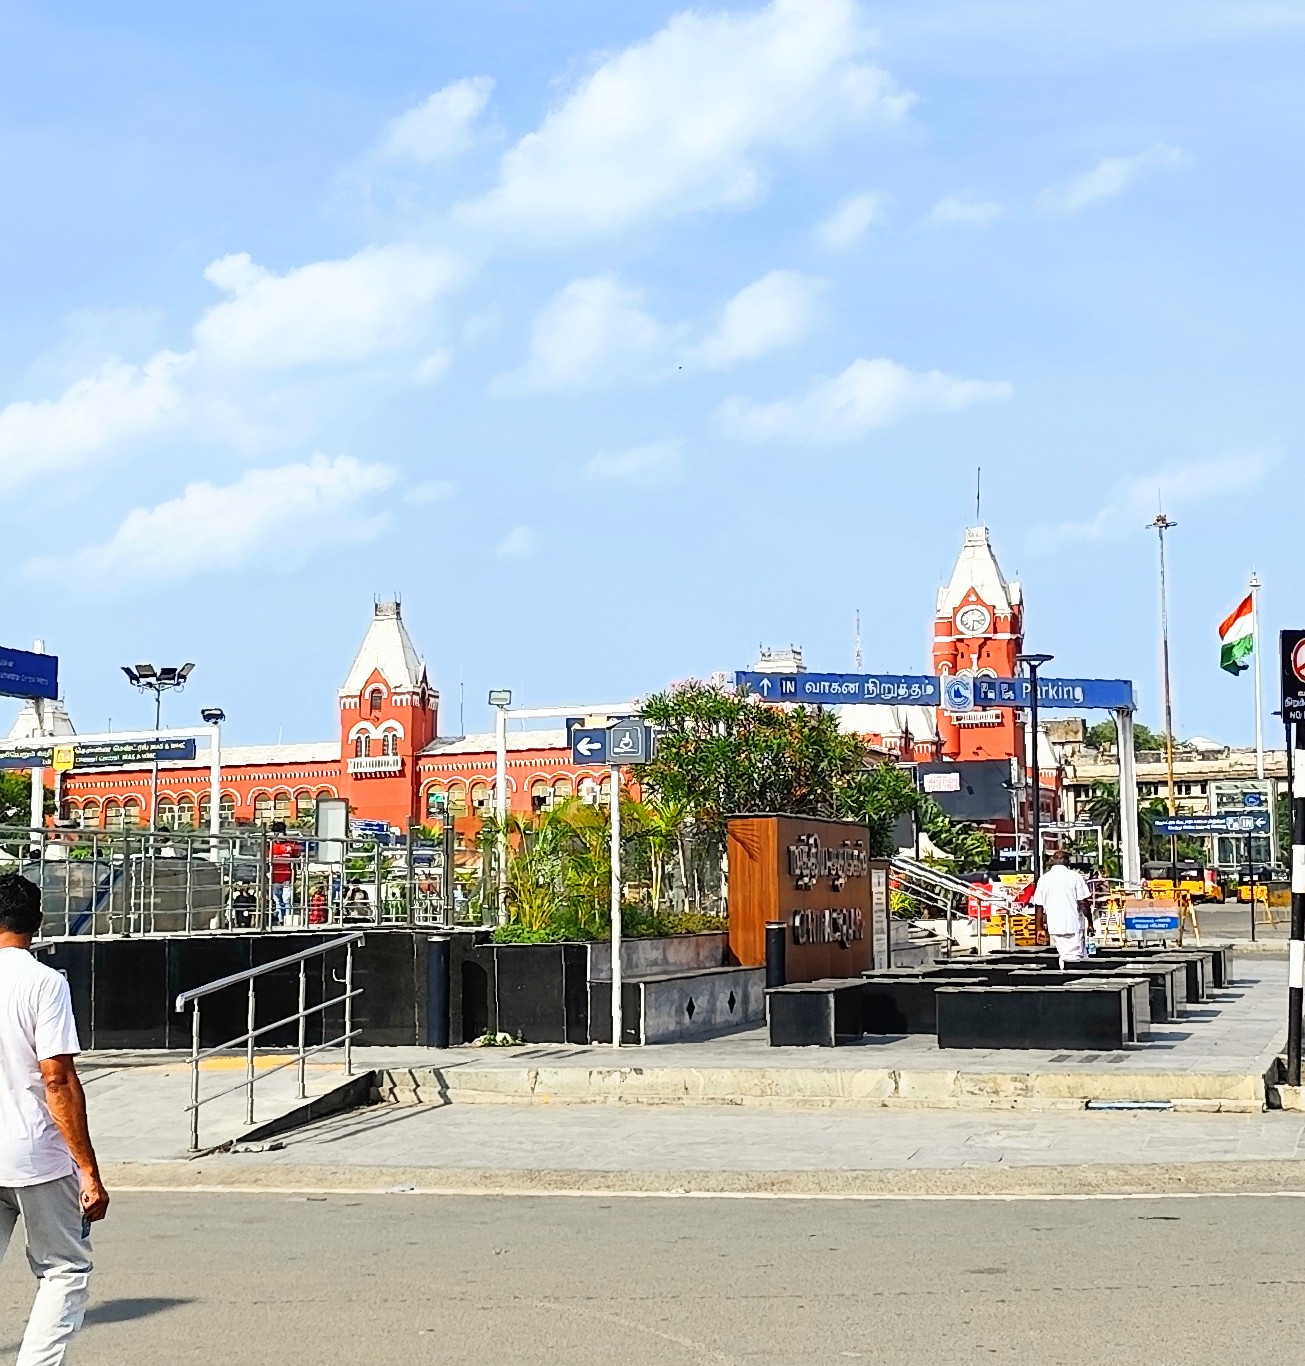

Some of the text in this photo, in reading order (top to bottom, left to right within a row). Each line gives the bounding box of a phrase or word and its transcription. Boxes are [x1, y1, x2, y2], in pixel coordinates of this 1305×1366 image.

[782, 680, 795, 693] IN
[805, 678, 935, 699] வாகன நிறுத்தம்
